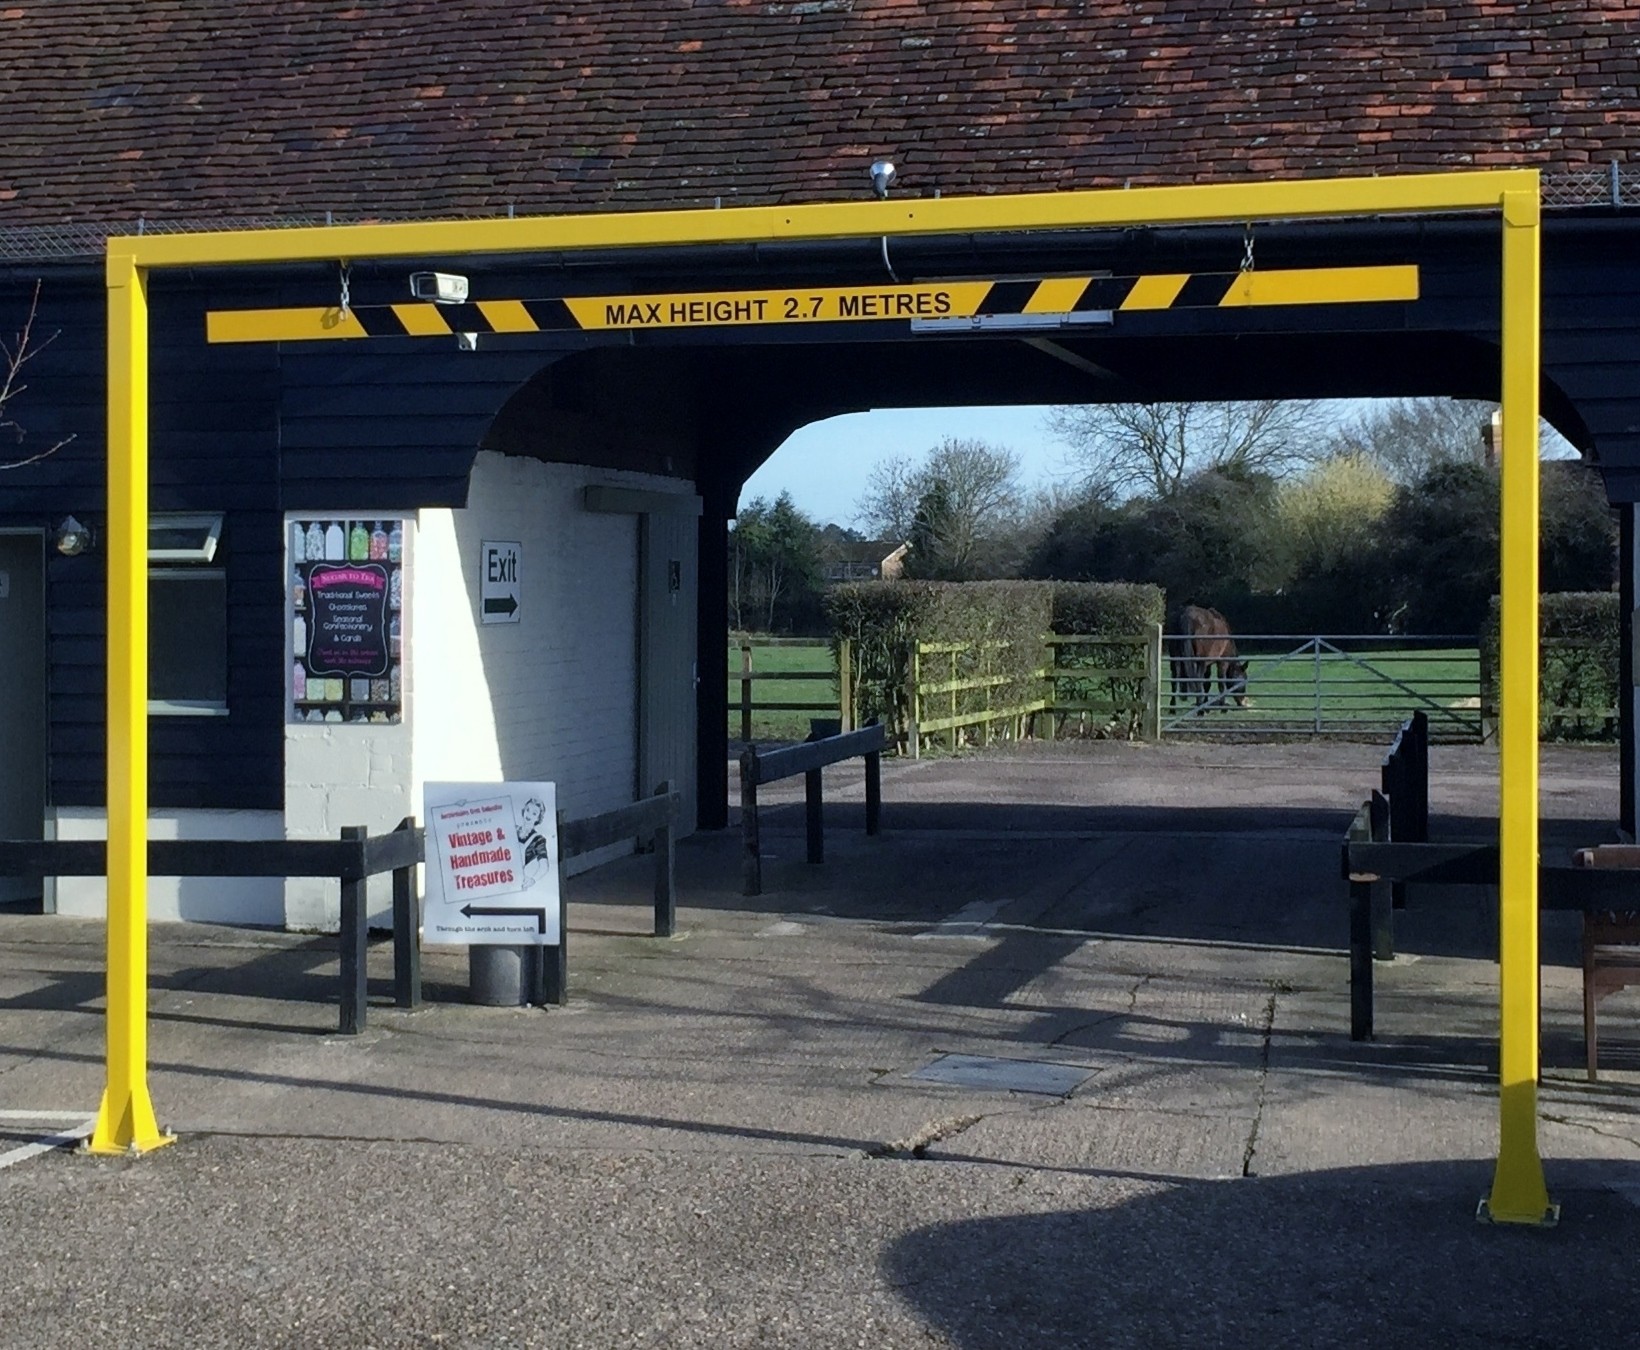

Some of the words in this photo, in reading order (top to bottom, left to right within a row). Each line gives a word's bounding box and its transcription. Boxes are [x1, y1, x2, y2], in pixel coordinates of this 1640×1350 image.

[606, 303, 662, 325] MAX
[670, 299, 768, 323] HEIGHT
[784, 297, 824, 319] 2.7
[839, 292, 951, 317] METRES
[488, 549, 517, 583] Exit
[317, 591, 354, 599] Traditional
[355, 591, 380, 599] Sweets
[323, 622, 373, 632] Confectionery
[333, 615, 363, 623] Seasonal
[448, 829, 493, 849] Vintage
[497, 827, 505, 841] &
[450, 846, 512, 870] Handmade
[454, 869, 514, 890] Treasures
[436, 925, 464, 933] Through
